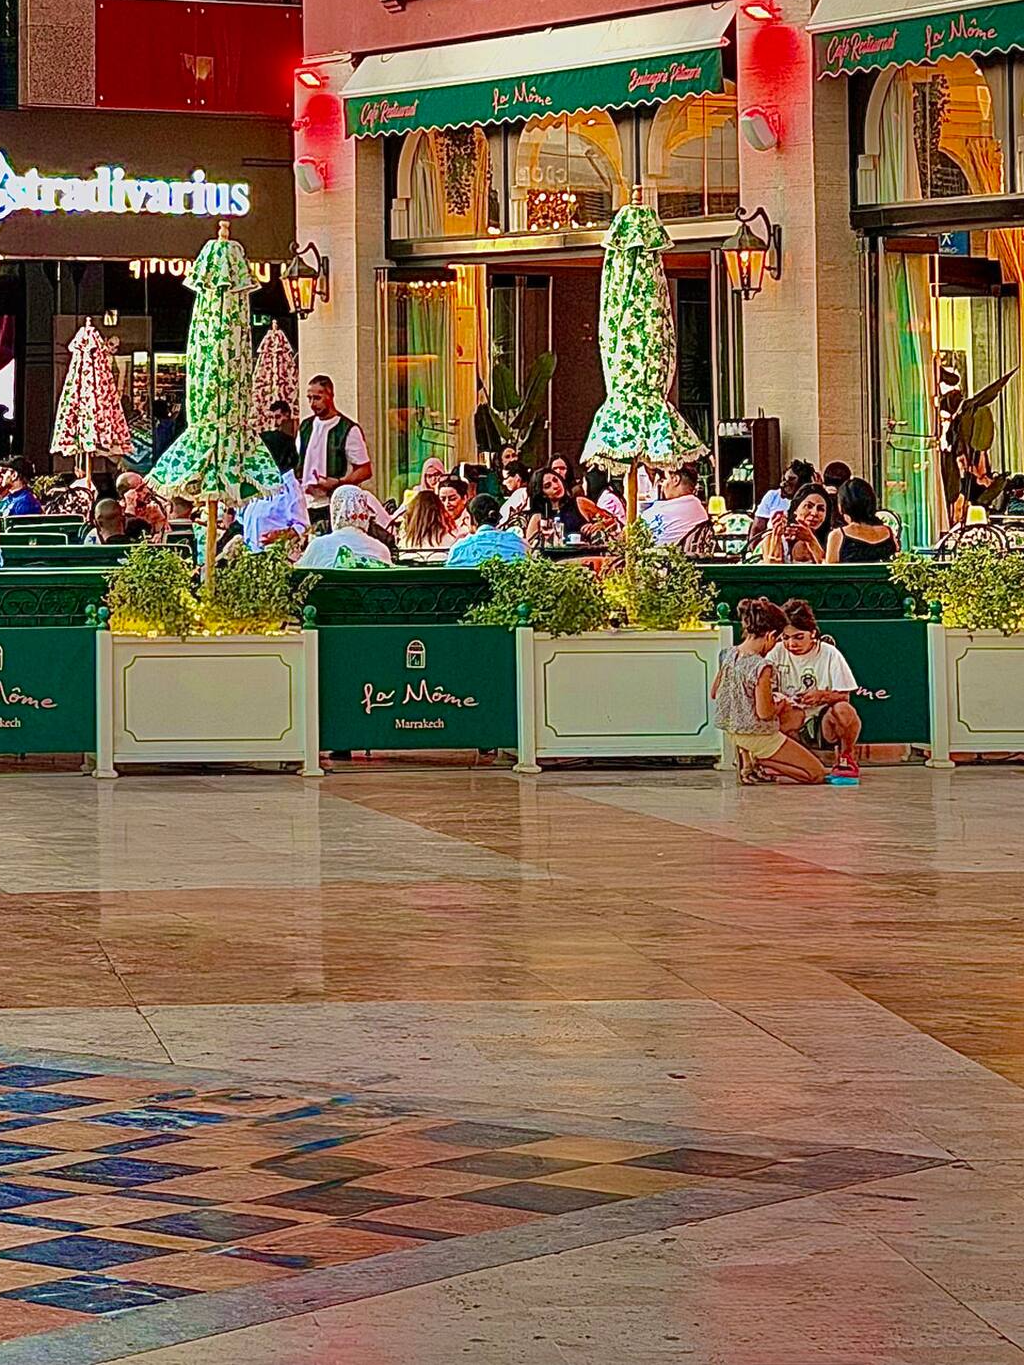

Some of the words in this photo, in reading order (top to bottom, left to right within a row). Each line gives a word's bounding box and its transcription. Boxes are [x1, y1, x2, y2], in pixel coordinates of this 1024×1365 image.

[925, 24, 944, 57] La
[949, 14, 998, 42] Môme
[492, 87, 510, 114] La
[513, 82, 553, 107] Môme
[361, 683, 396, 714] La
[402, 679, 479, 707] Môme
[395, 718, 445, 729] Marrakech
